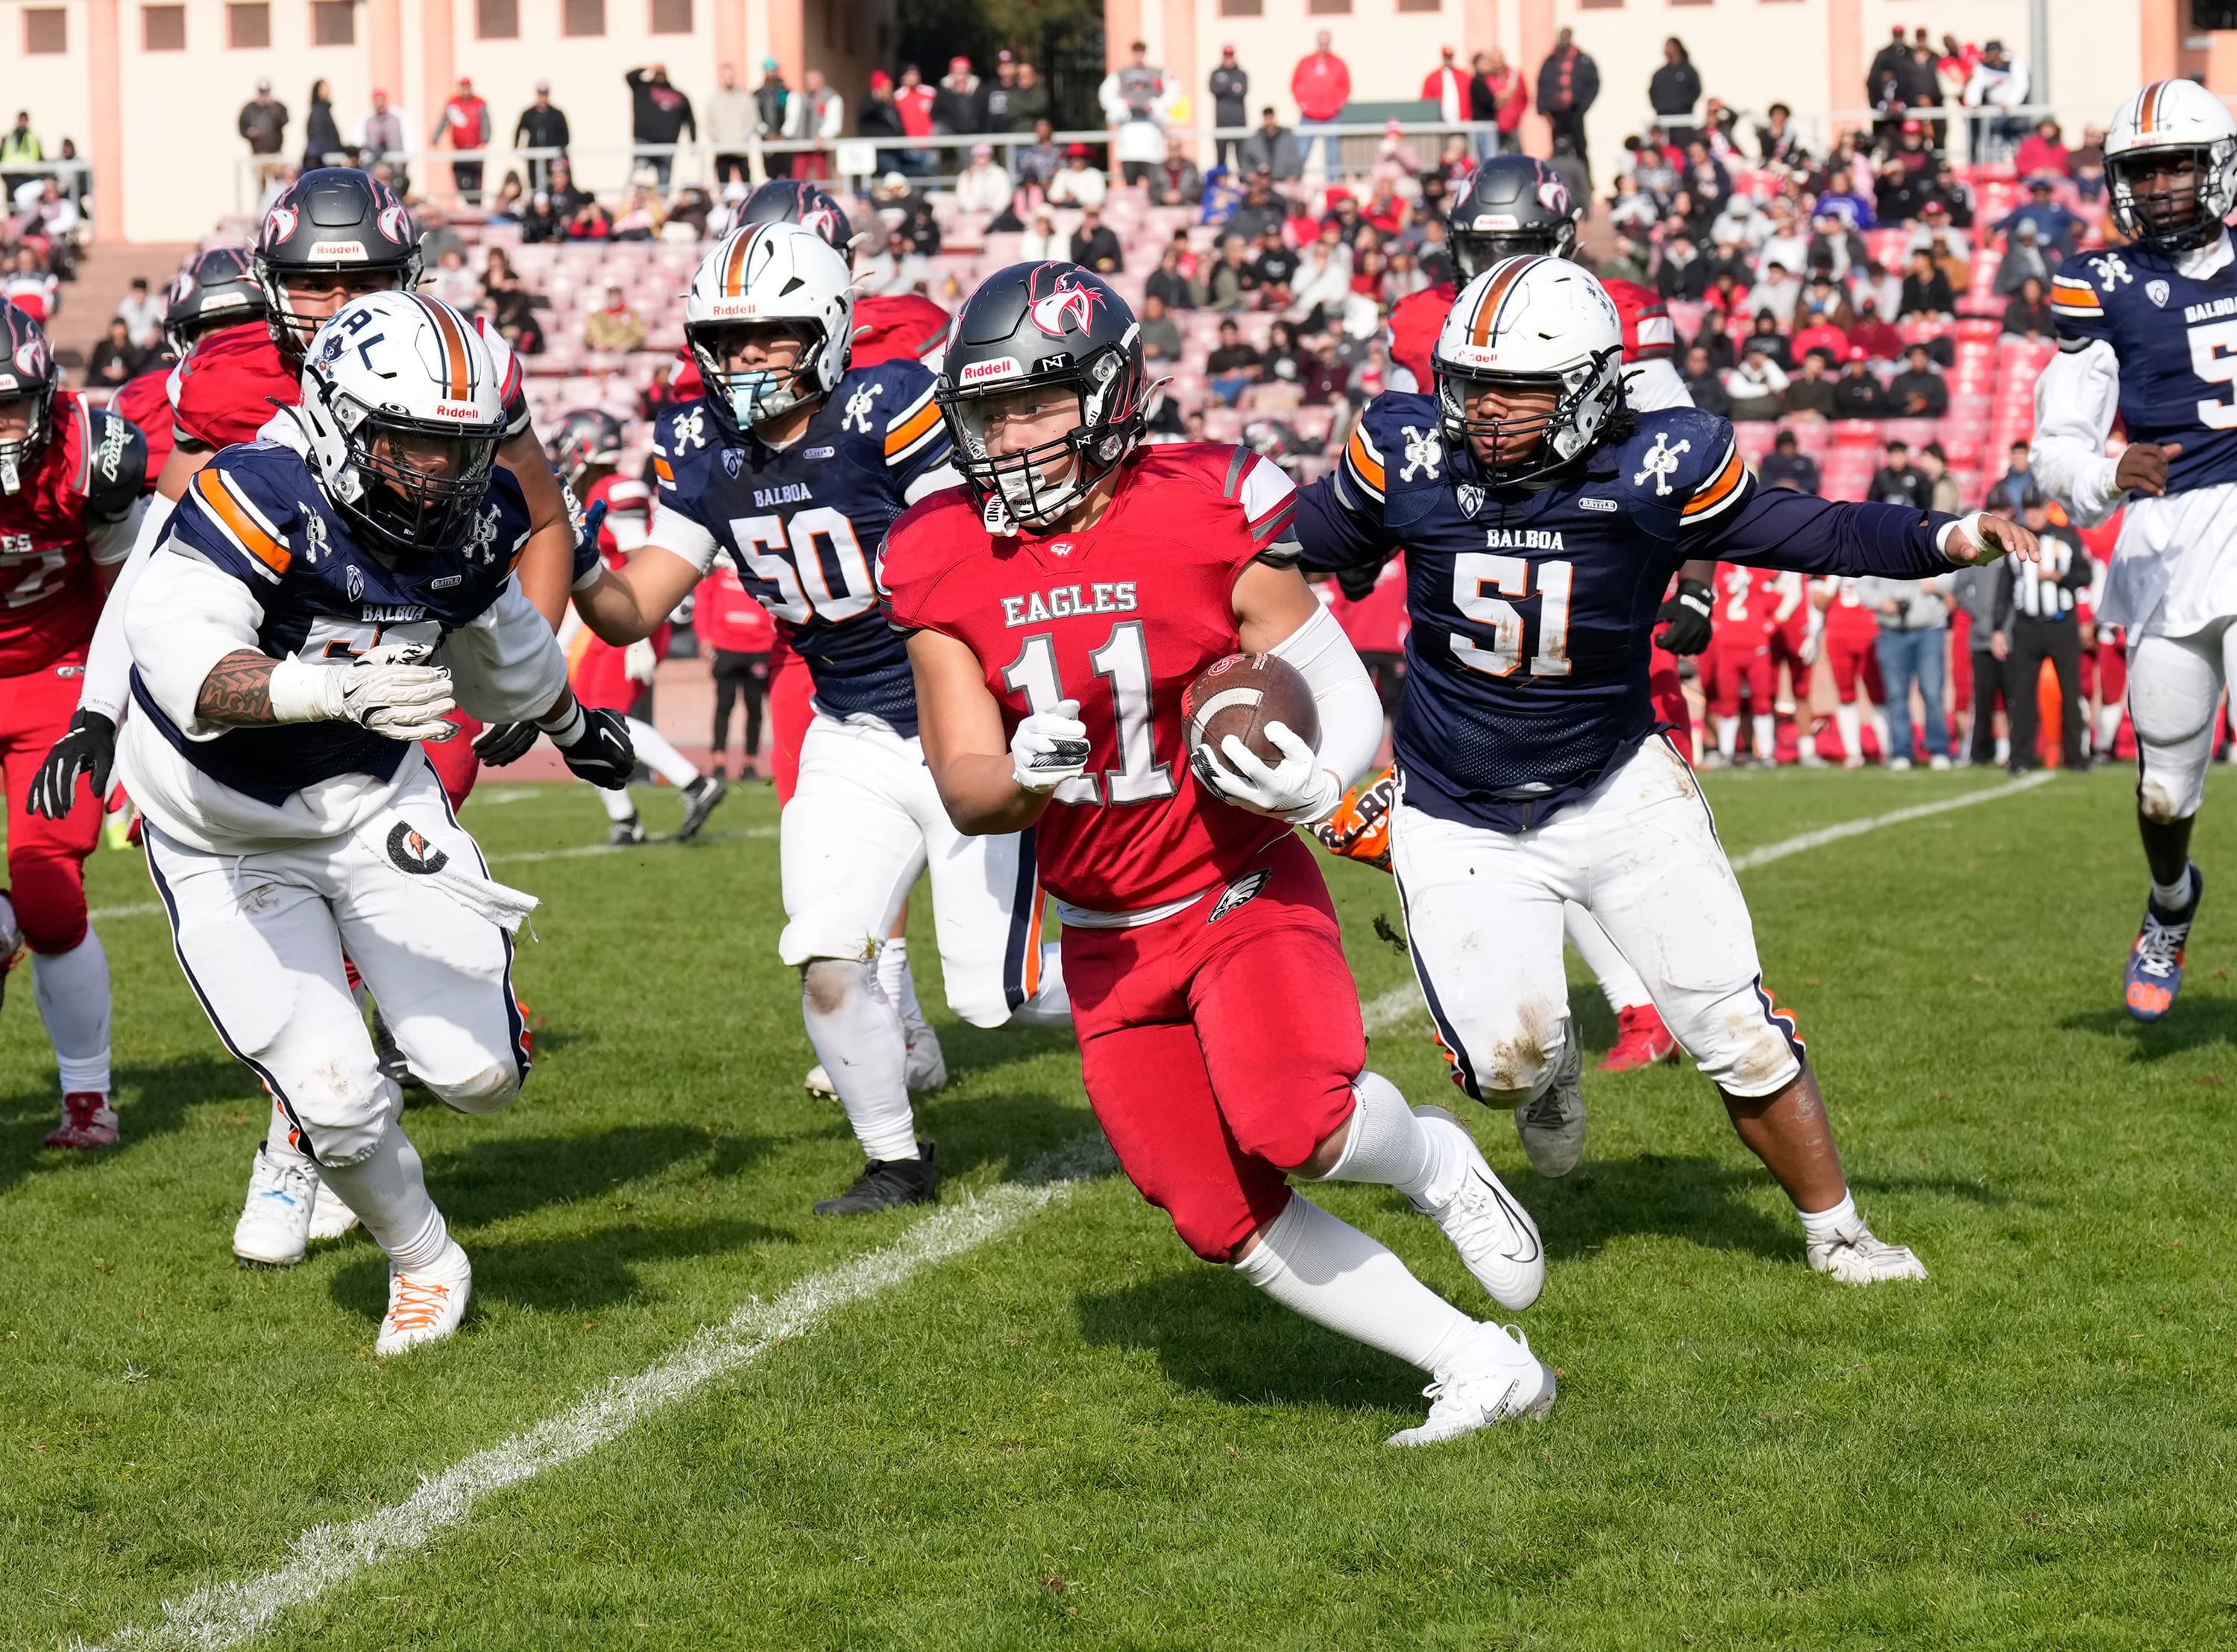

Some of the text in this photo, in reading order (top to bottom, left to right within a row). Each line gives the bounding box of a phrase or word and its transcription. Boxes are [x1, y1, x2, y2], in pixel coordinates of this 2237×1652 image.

[317, 245, 359, 254] Riddell
[714, 305, 756, 315] Riddell
[964, 360, 1011, 379] Riddell
[437, 405, 479, 419] Riddell
[752, 482, 813, 508] BALBOA
[1582, 499, 1615, 510] BATTLE
[1486, 529, 1564, 551] BALBOA
[729, 506, 878, 625] 50
[361, 604, 427, 623] BALBOA
[1001, 581, 1138, 629] EAGLES
[1450, 552, 1575, 678] 51
[1001, 620, 1179, 807] 11
